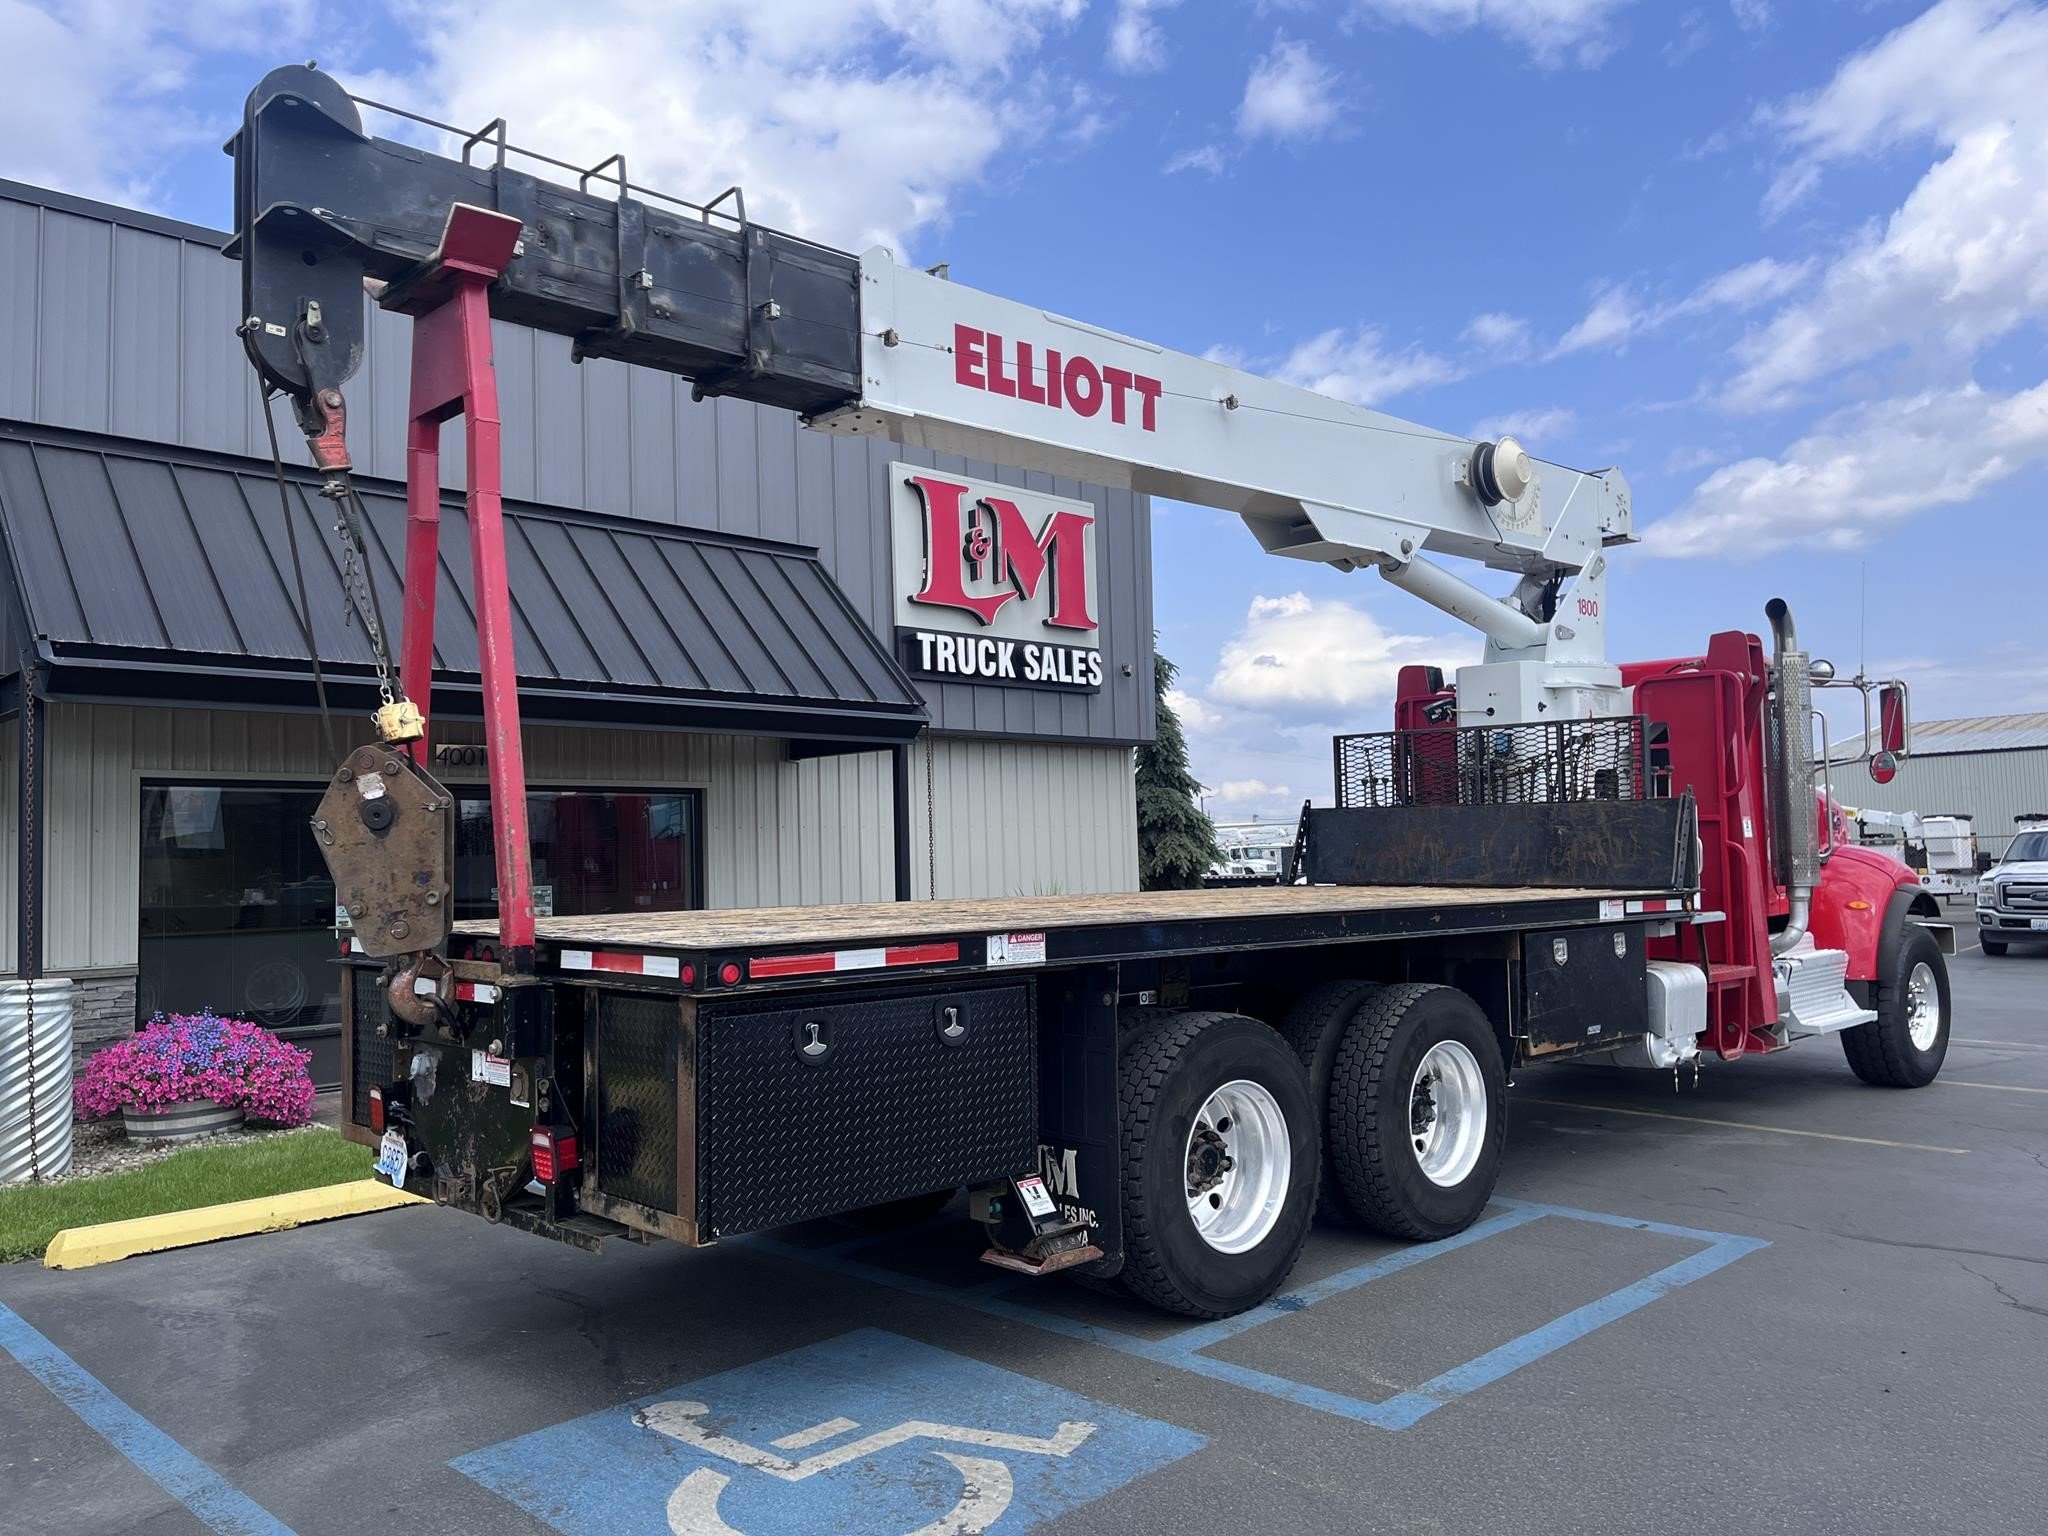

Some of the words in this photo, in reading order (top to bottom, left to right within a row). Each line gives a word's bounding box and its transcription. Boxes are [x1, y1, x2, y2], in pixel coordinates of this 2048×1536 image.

[954, 323, 1162, 432] ELLIOTT
[905, 476, 1098, 630] L&M
[1577, 598, 1598, 617] 1800
[916, 632, 1016, 678] TRUCK
[1023, 644, 1103, 687] SALES
[1018, 933, 1043, 942] DANGER
